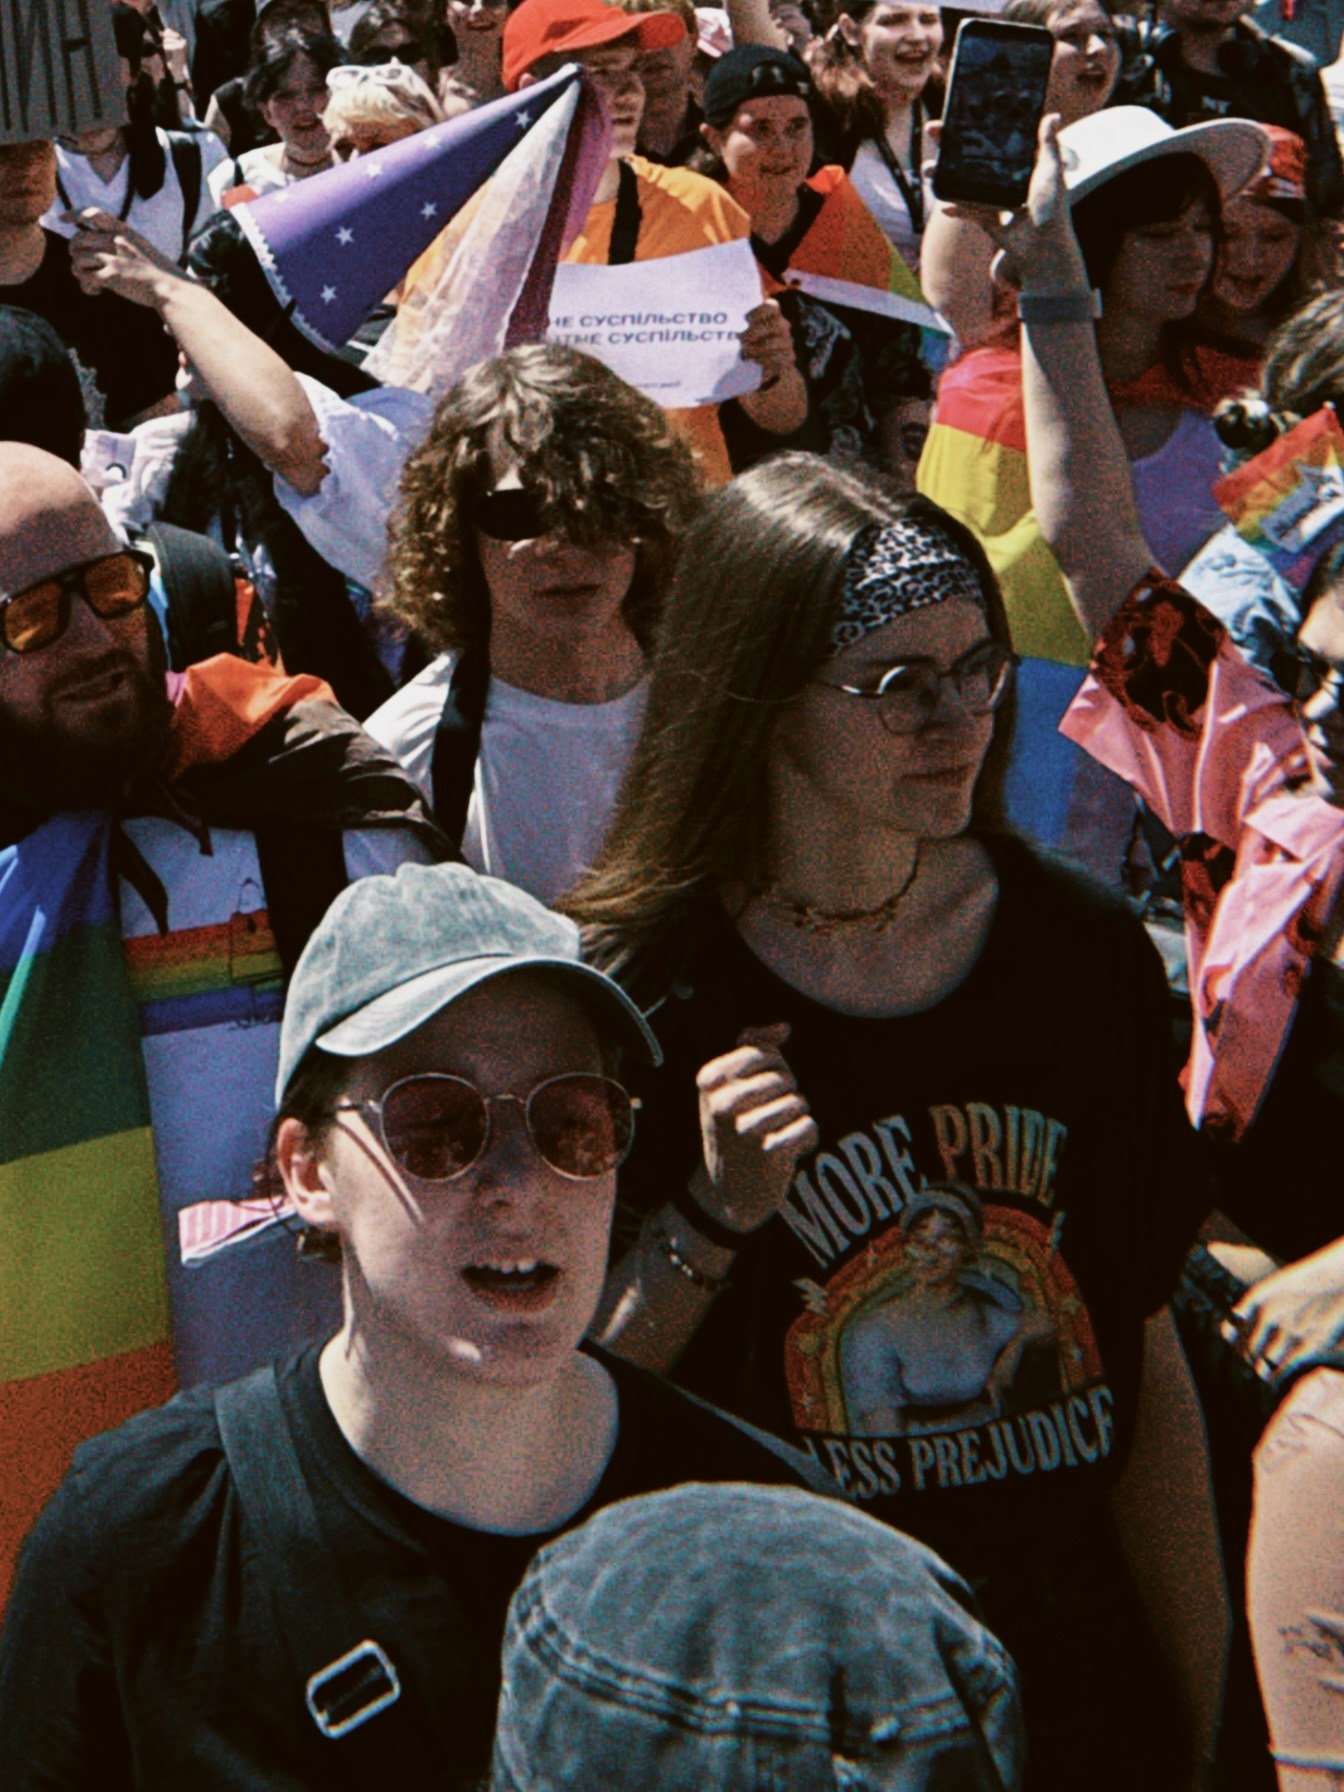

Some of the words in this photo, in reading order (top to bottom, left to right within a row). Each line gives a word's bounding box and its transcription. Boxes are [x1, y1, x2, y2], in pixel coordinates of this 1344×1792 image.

[579, 311, 728, 328] СУСПІЛЬСТВО
[607, 328, 740, 345] СУСПІЛЬСТВ
[781, 1114, 928, 1270] MORE
[928, 1101, 1069, 1208] PRIDE
[908, 1383, 1116, 1491] PREJUDICE
